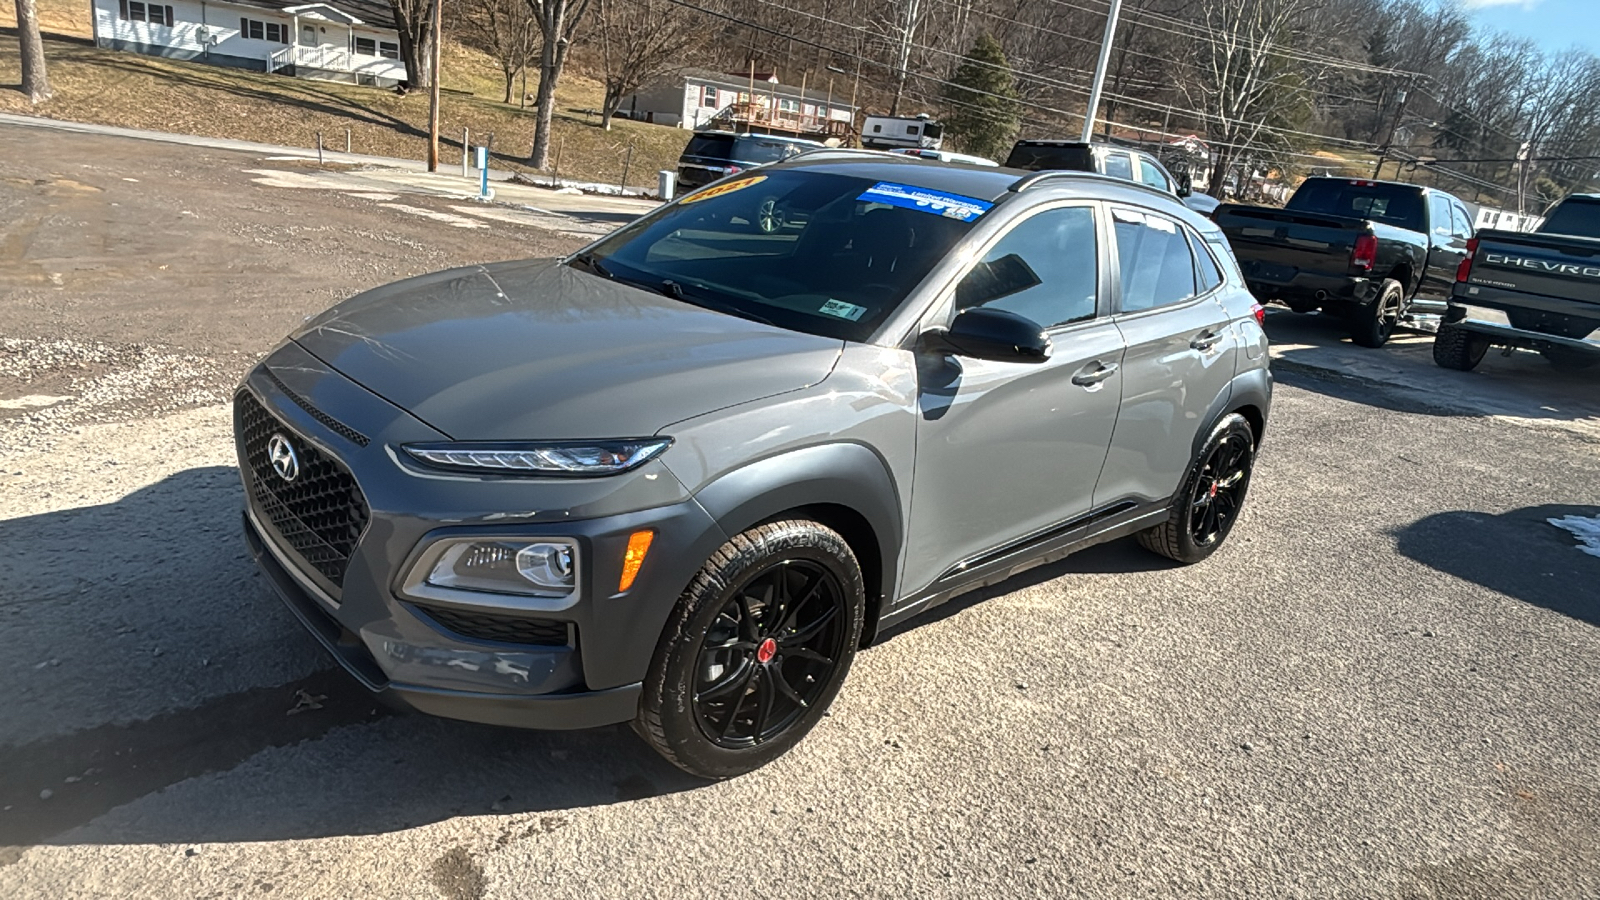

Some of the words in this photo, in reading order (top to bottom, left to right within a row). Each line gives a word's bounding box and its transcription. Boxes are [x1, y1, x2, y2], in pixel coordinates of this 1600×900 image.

[911, 191, 943, 201] Limited
[943, 197, 983, 210] Warranty
[1486, 254, 1600, 277] CHEVRO
